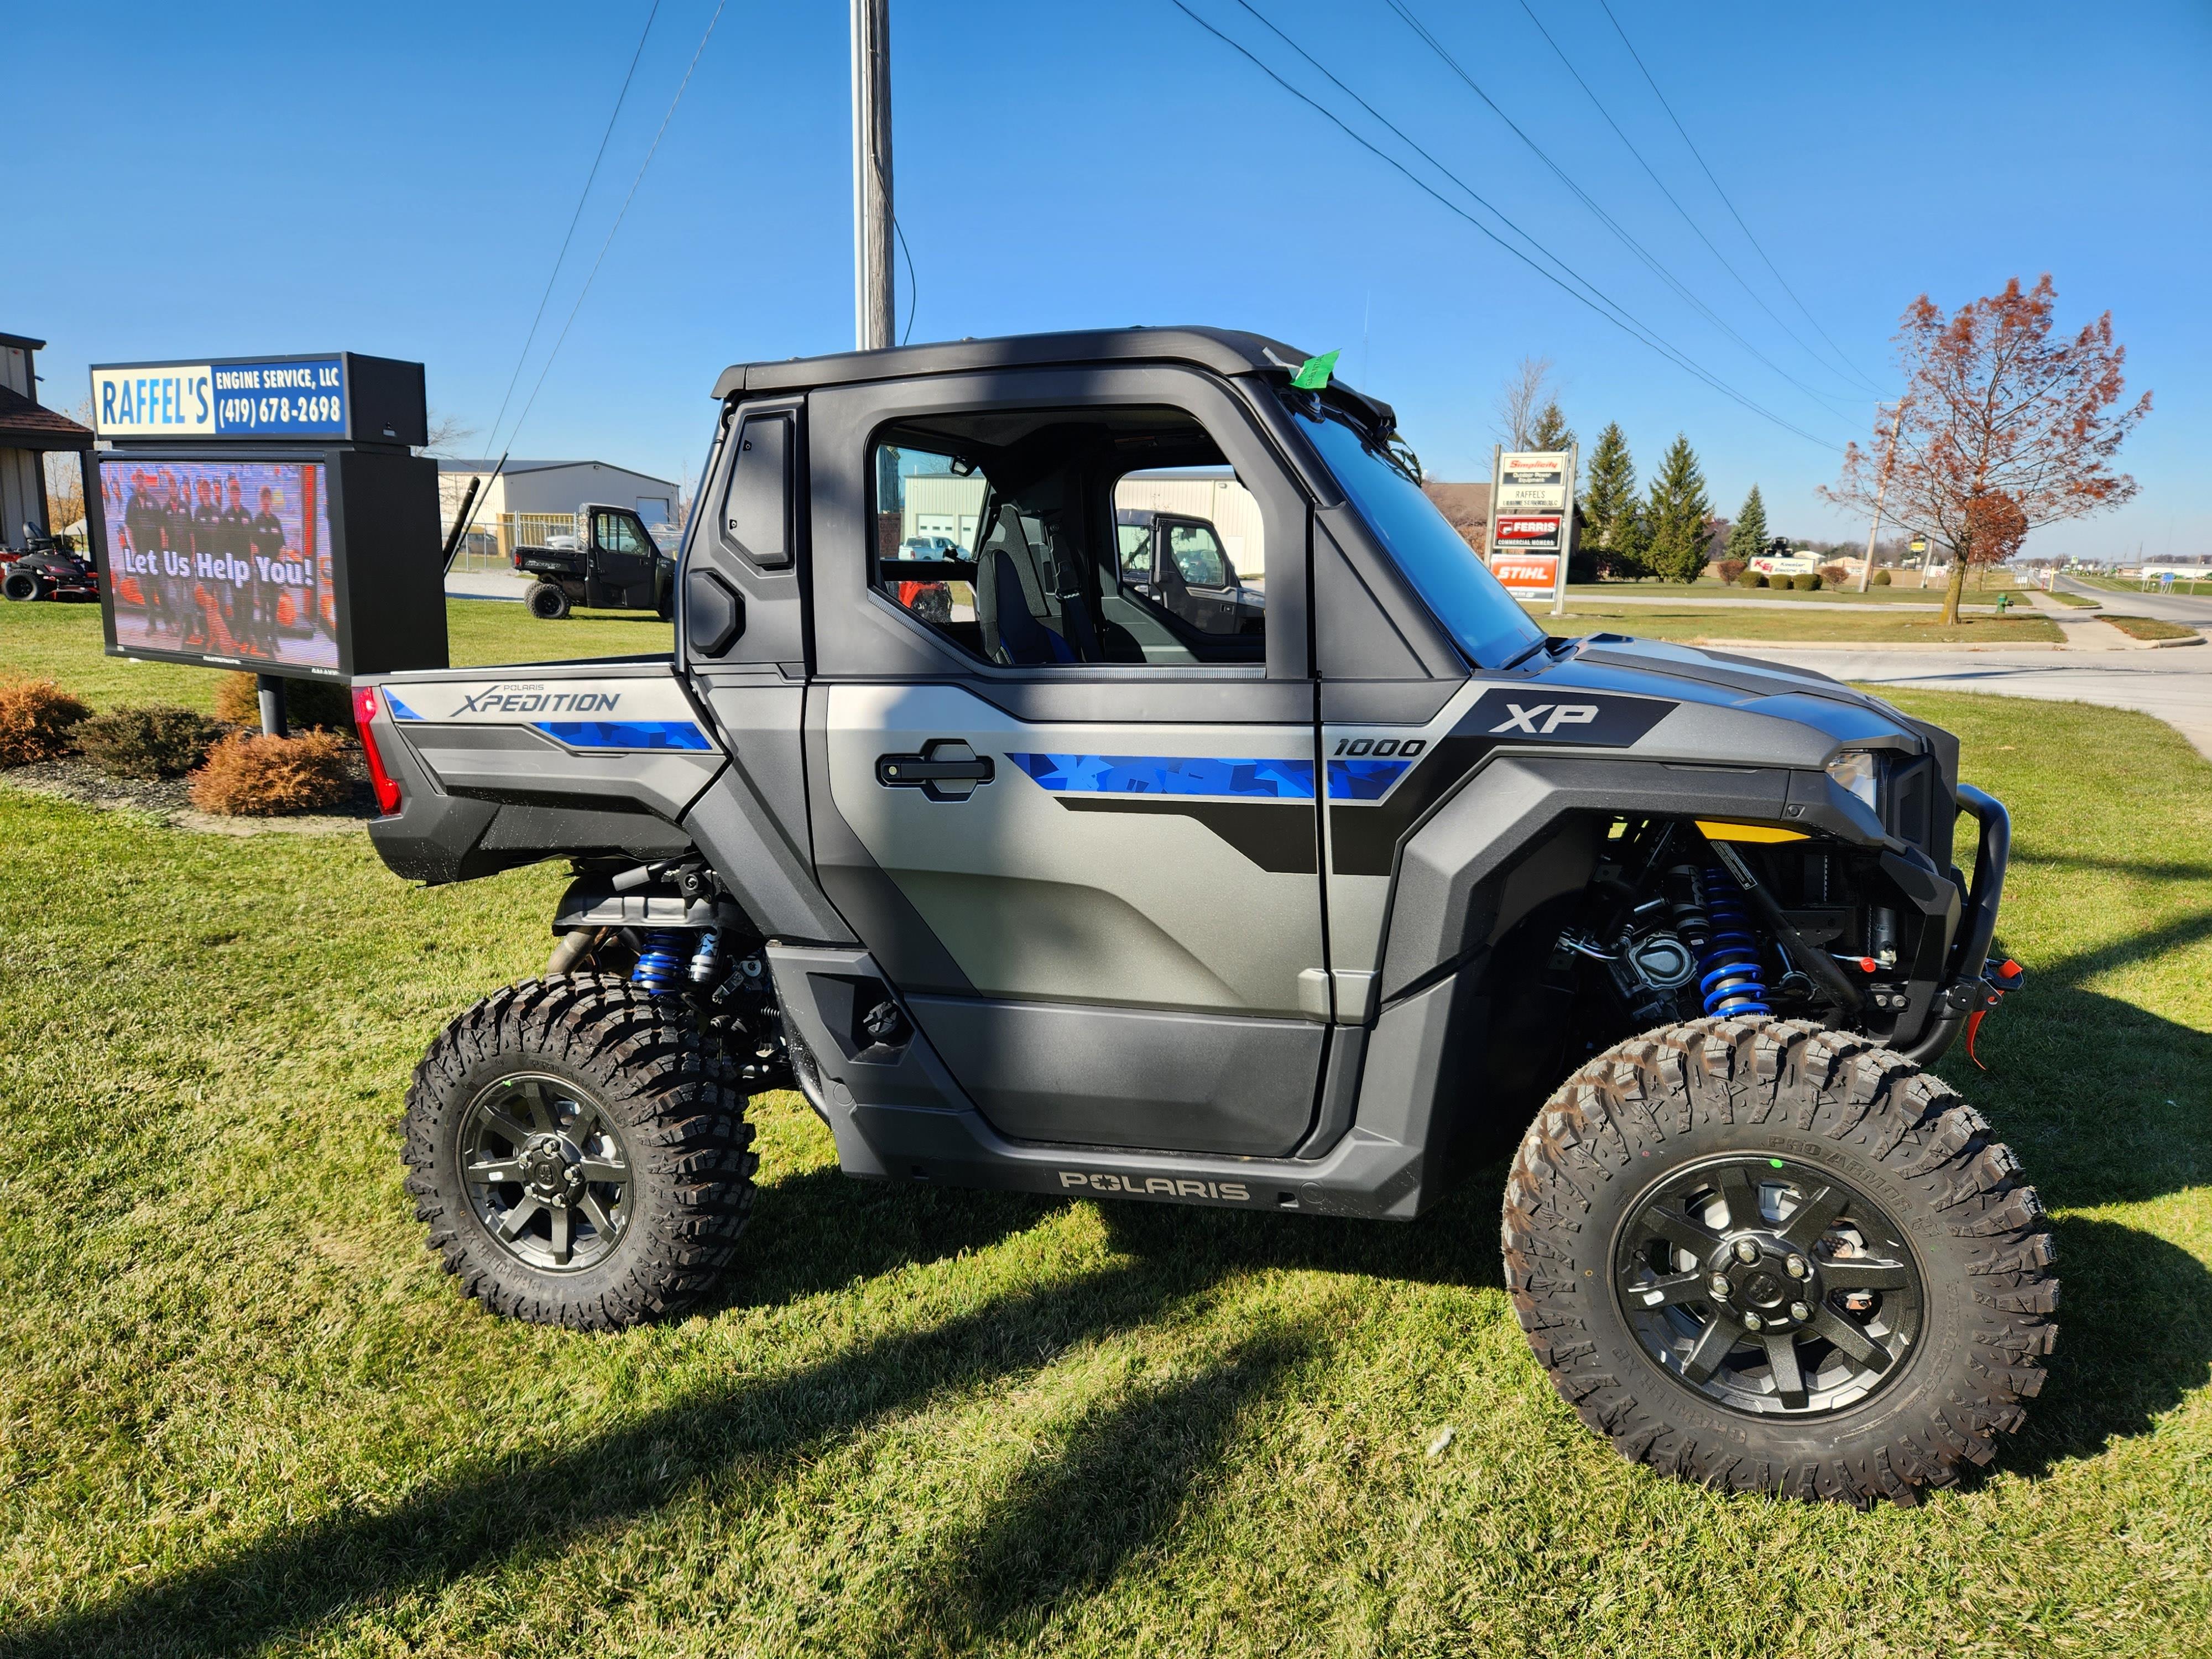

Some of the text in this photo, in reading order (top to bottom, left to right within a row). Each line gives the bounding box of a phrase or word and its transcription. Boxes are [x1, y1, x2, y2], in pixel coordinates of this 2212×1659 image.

[216, 367, 339, 390] ENGINE SERVICE, LLC
[102, 377, 209, 425] RAFFEL'S
[219, 395, 341, 429] (419) 678-2698
[1510, 460, 1558, 469] Simplicity
[1516, 490, 1546, 498] RAFFEL'S
[1514, 521, 1557, 532] FERRIS
[123, 549, 315, 588] Let Us Help You!
[1497, 566, 1548, 580] STIHL
[449, 685, 622, 717] XPEDITION
[1488, 704, 1599, 733] XP
[1334, 739, 1427, 757] 1000
[1058, 1171, 1250, 1201] POLARIS
[1768, 1135, 1912, 1213] PRO ARMOR
